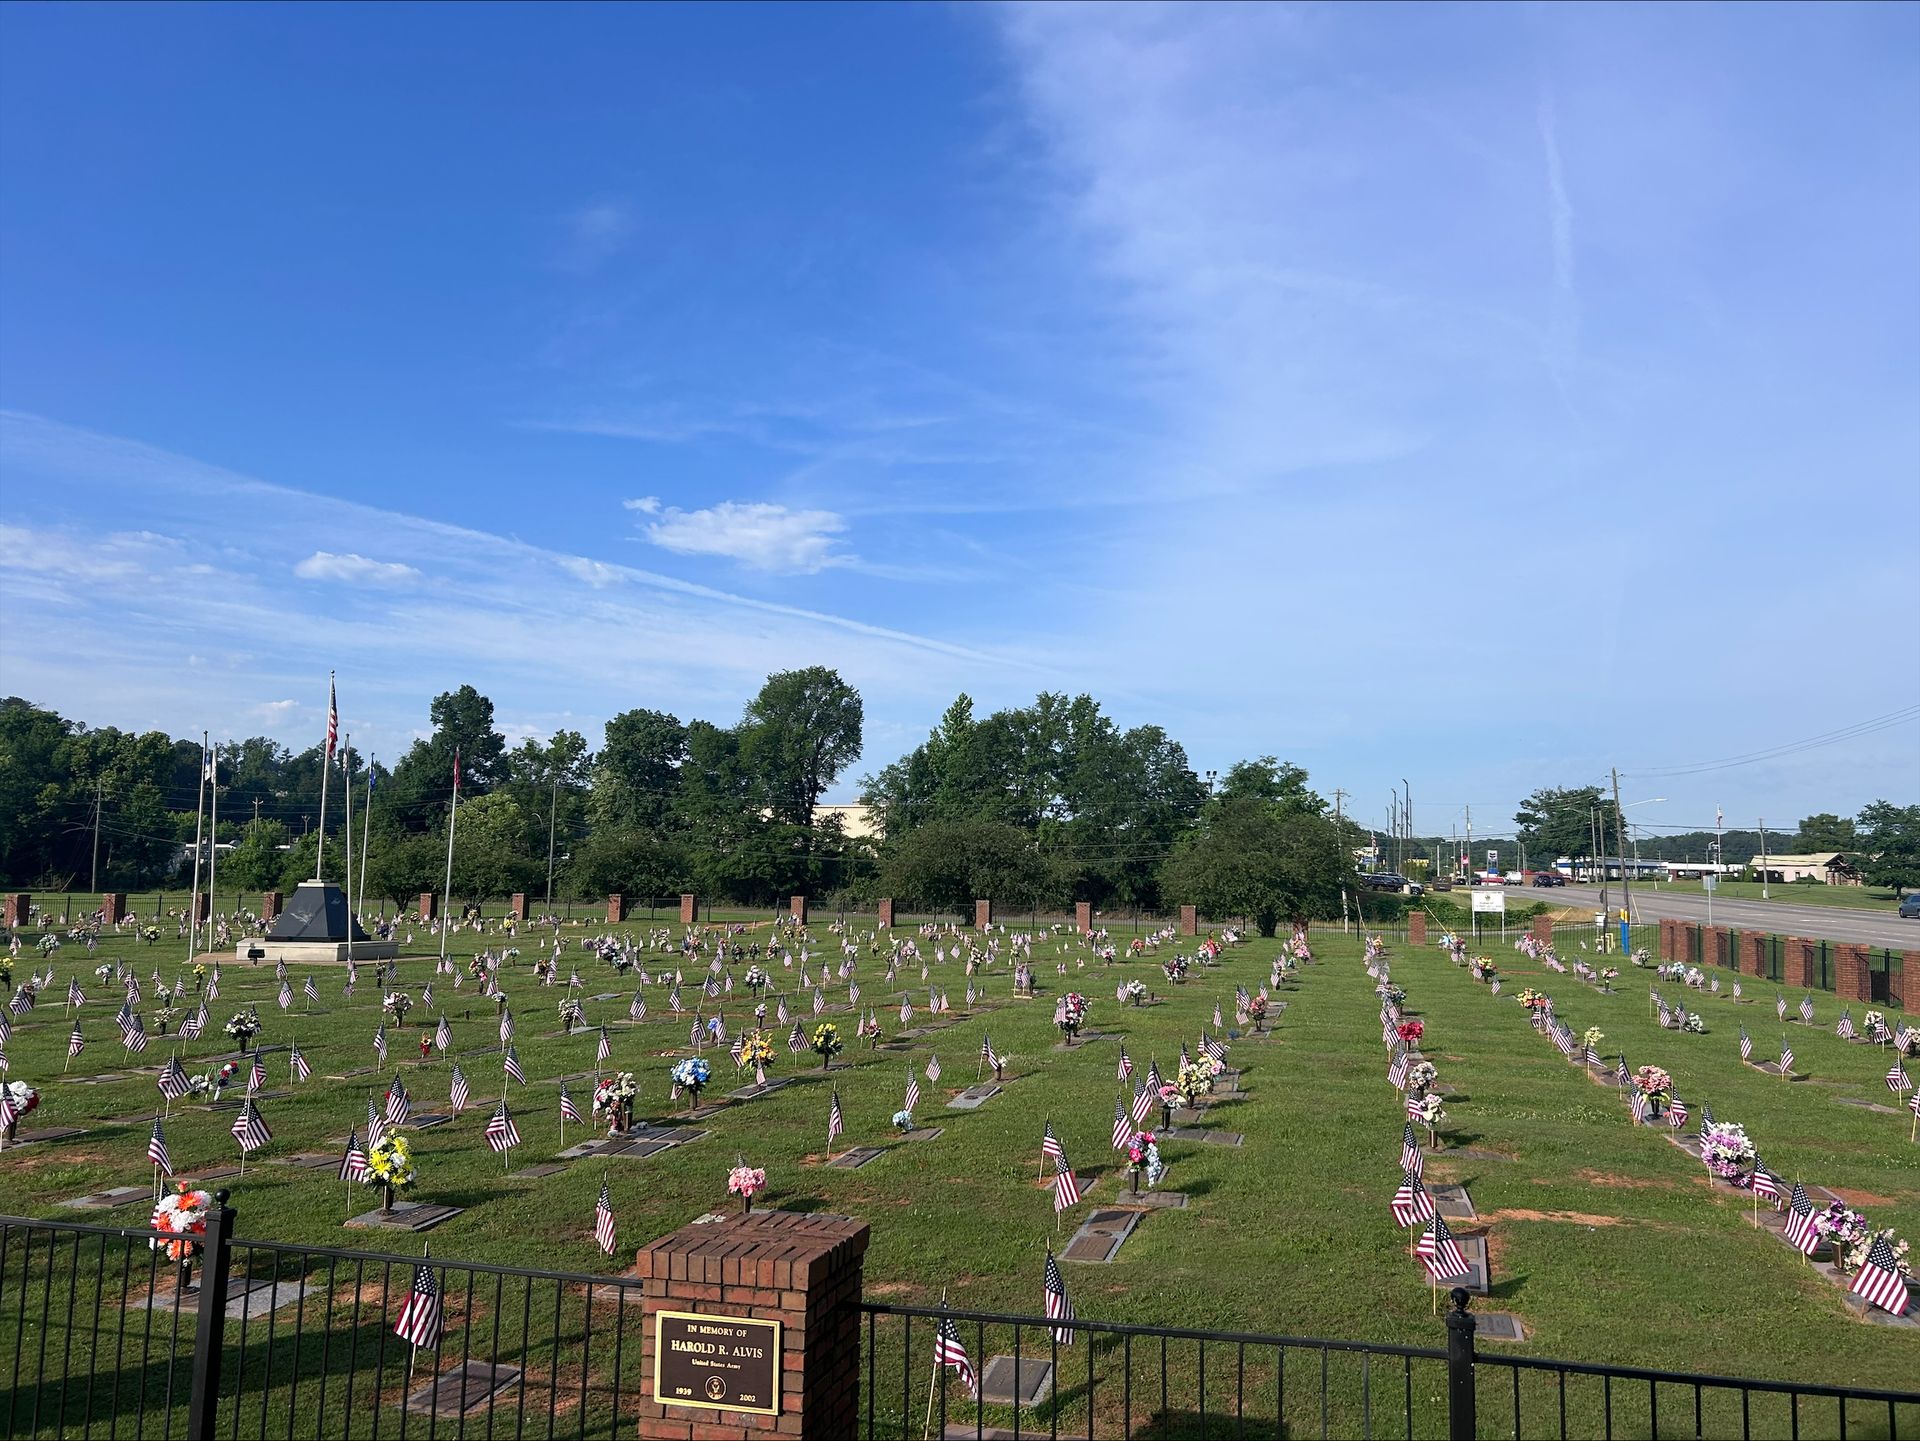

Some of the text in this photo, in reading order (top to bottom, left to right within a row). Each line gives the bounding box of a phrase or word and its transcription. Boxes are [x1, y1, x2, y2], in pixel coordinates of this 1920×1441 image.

[687, 1324, 697, 1333] IN
[699, 1326, 734, 1336] MEMORY
[671, 1340, 763, 1358] HAROLD R. ALVIS
[676, 1387, 692, 1395] 1939
[739, 1394, 756, 1402] 2002
